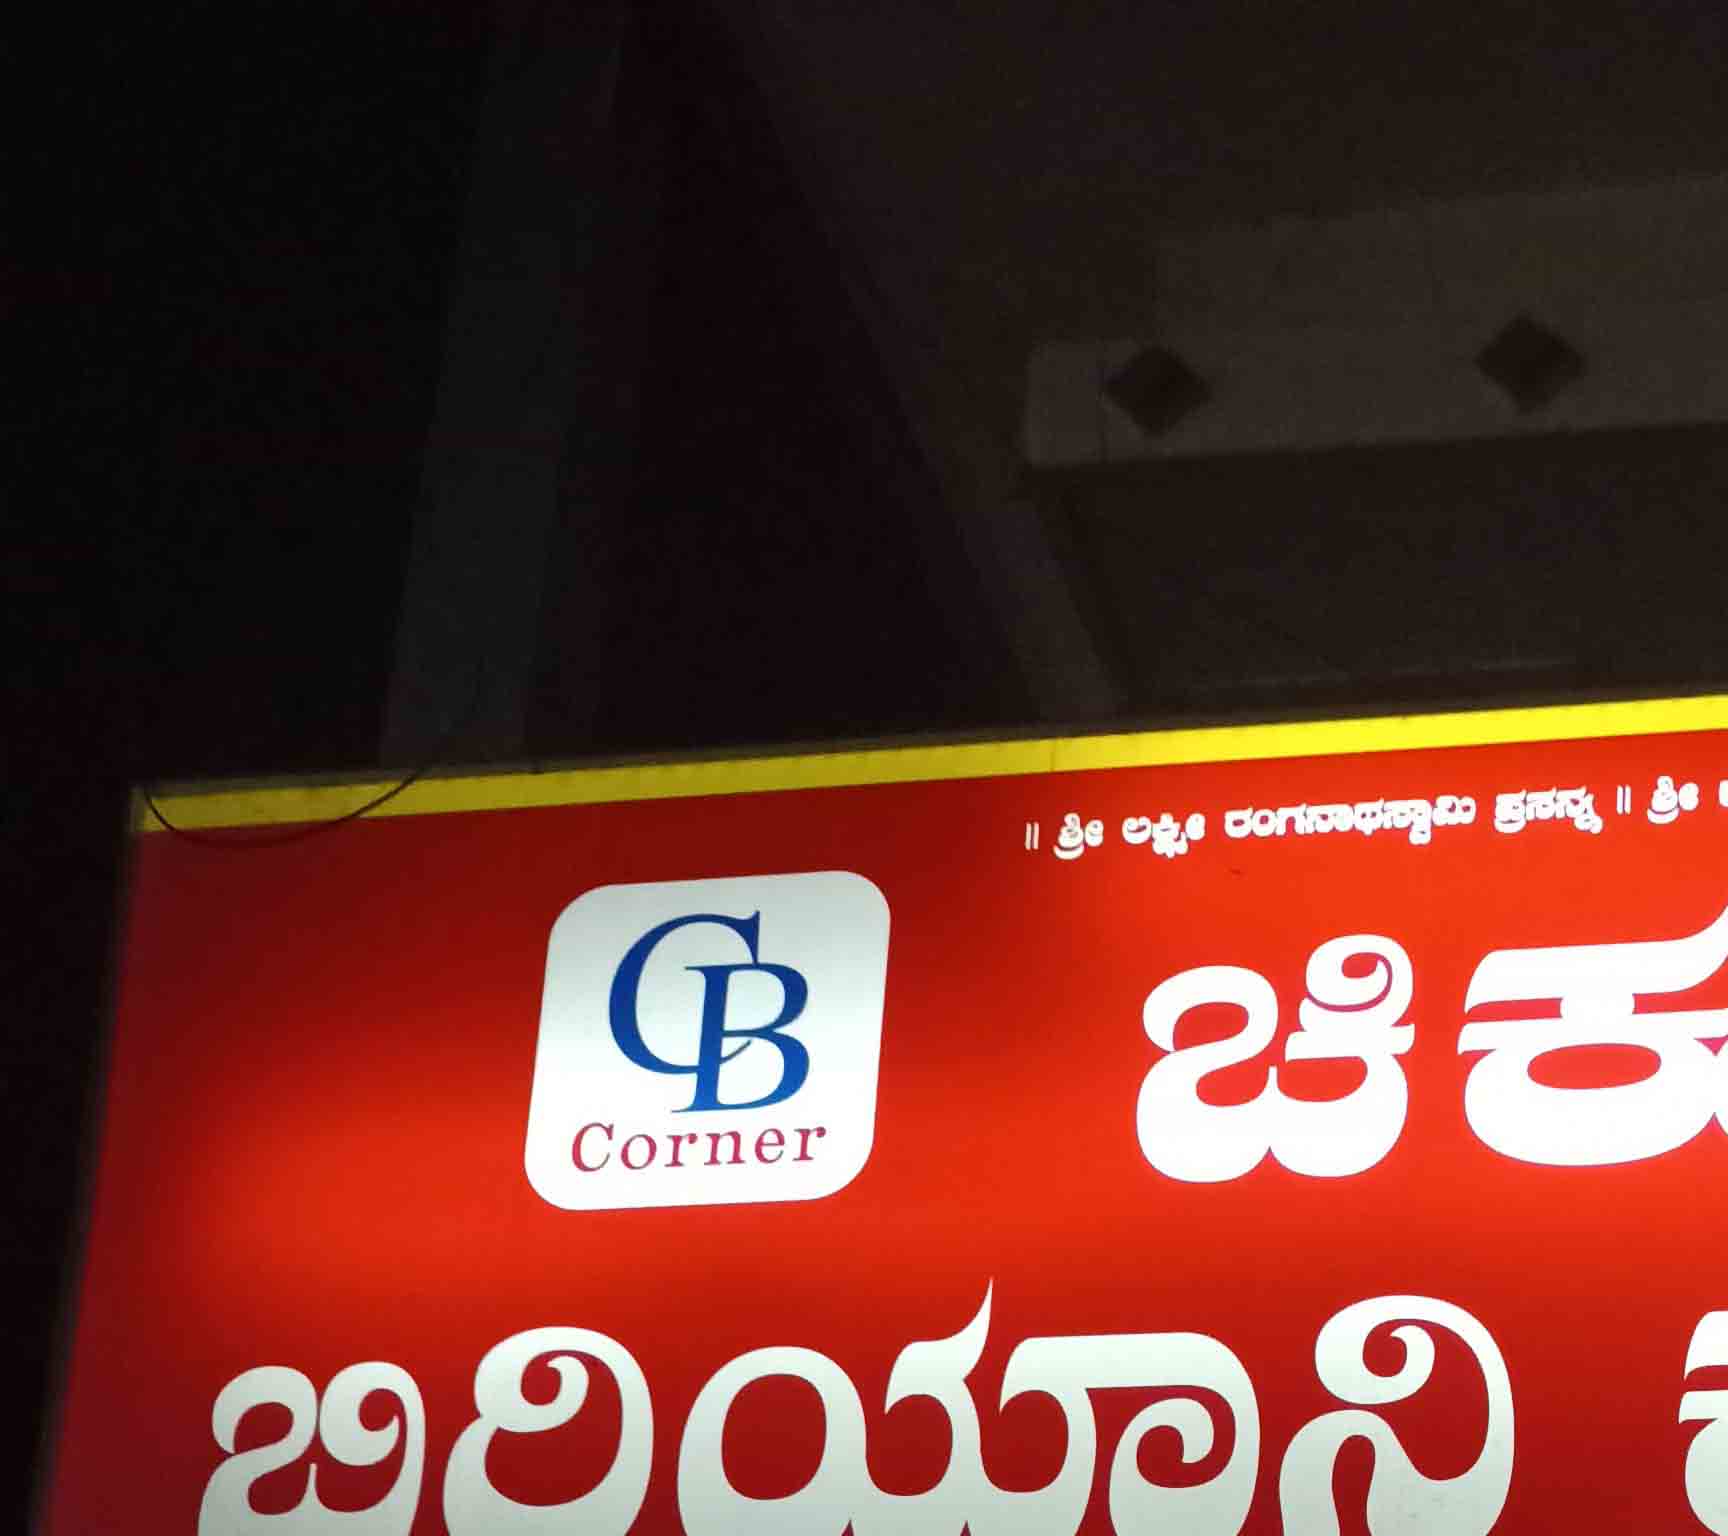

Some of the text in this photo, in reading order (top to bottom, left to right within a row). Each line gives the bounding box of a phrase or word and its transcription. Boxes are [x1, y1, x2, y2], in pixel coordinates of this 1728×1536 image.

[1052, 811, 1105, 861] ಶ್ರೀ
[1223, 794, 1478, 847] ರಂಗನಾಥಸ್ವಾಮಿ
[1492, 785, 1605, 836] ಪ್ರಸನ್ನ
[1645, 774, 1701, 826] ಶ್ರೀ
[570, 1122, 828, 1173] Corner
